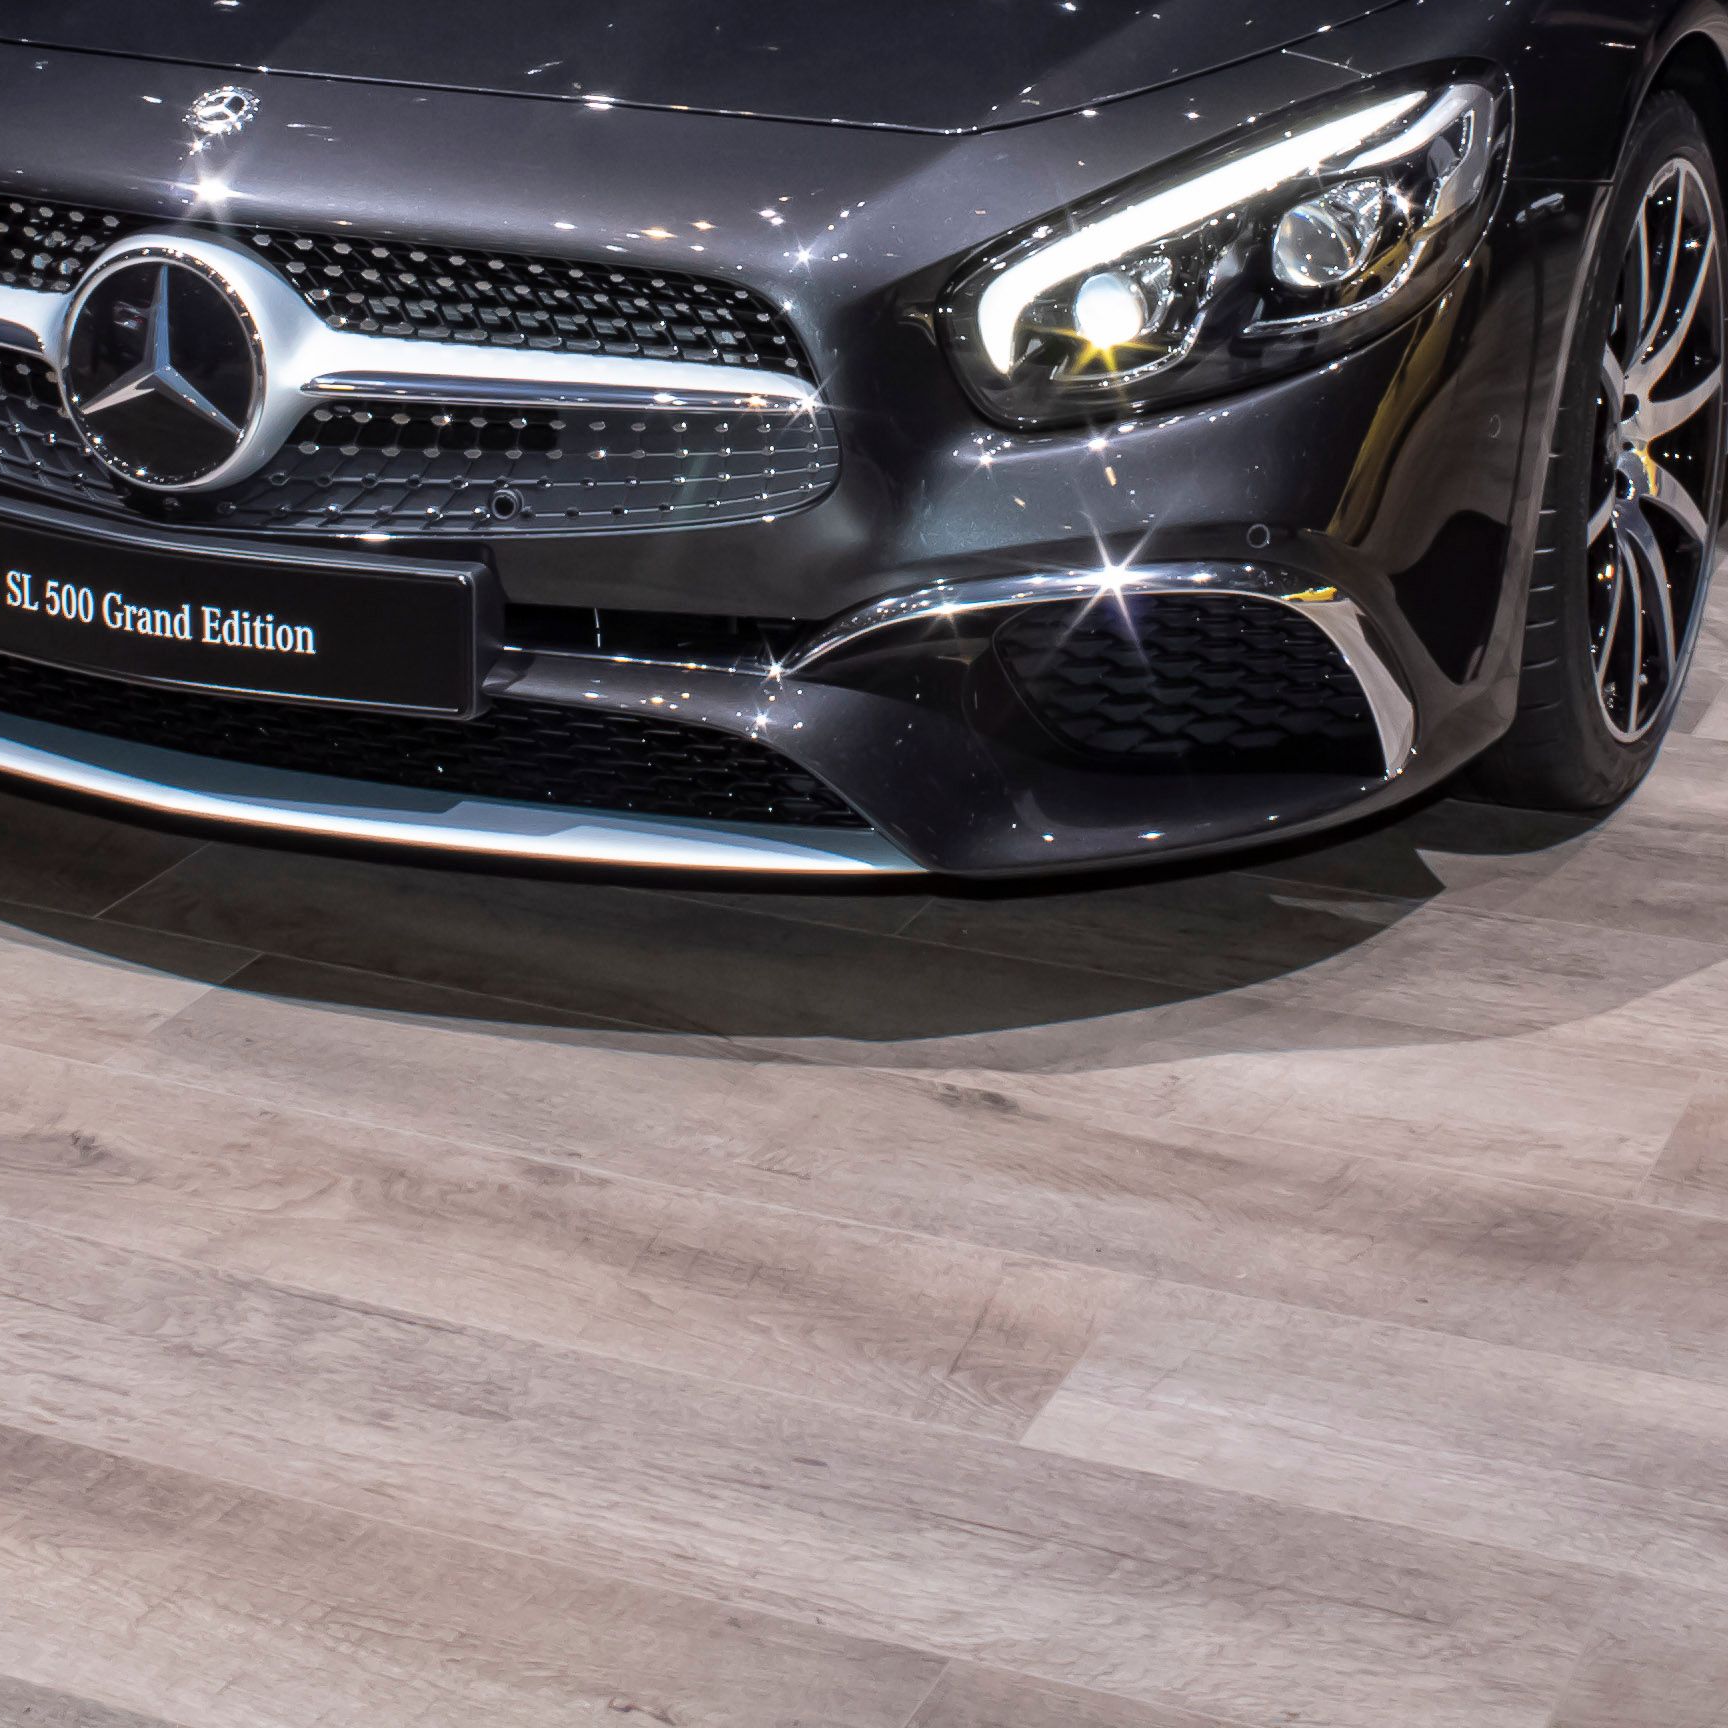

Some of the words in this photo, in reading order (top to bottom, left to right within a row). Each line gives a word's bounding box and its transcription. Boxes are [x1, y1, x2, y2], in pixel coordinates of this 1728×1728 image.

[5, 569, 39, 614] SL
[44, 580, 95, 625] 500
[101, 591, 193, 641] Grand
[201, 606, 317, 656] Edition
